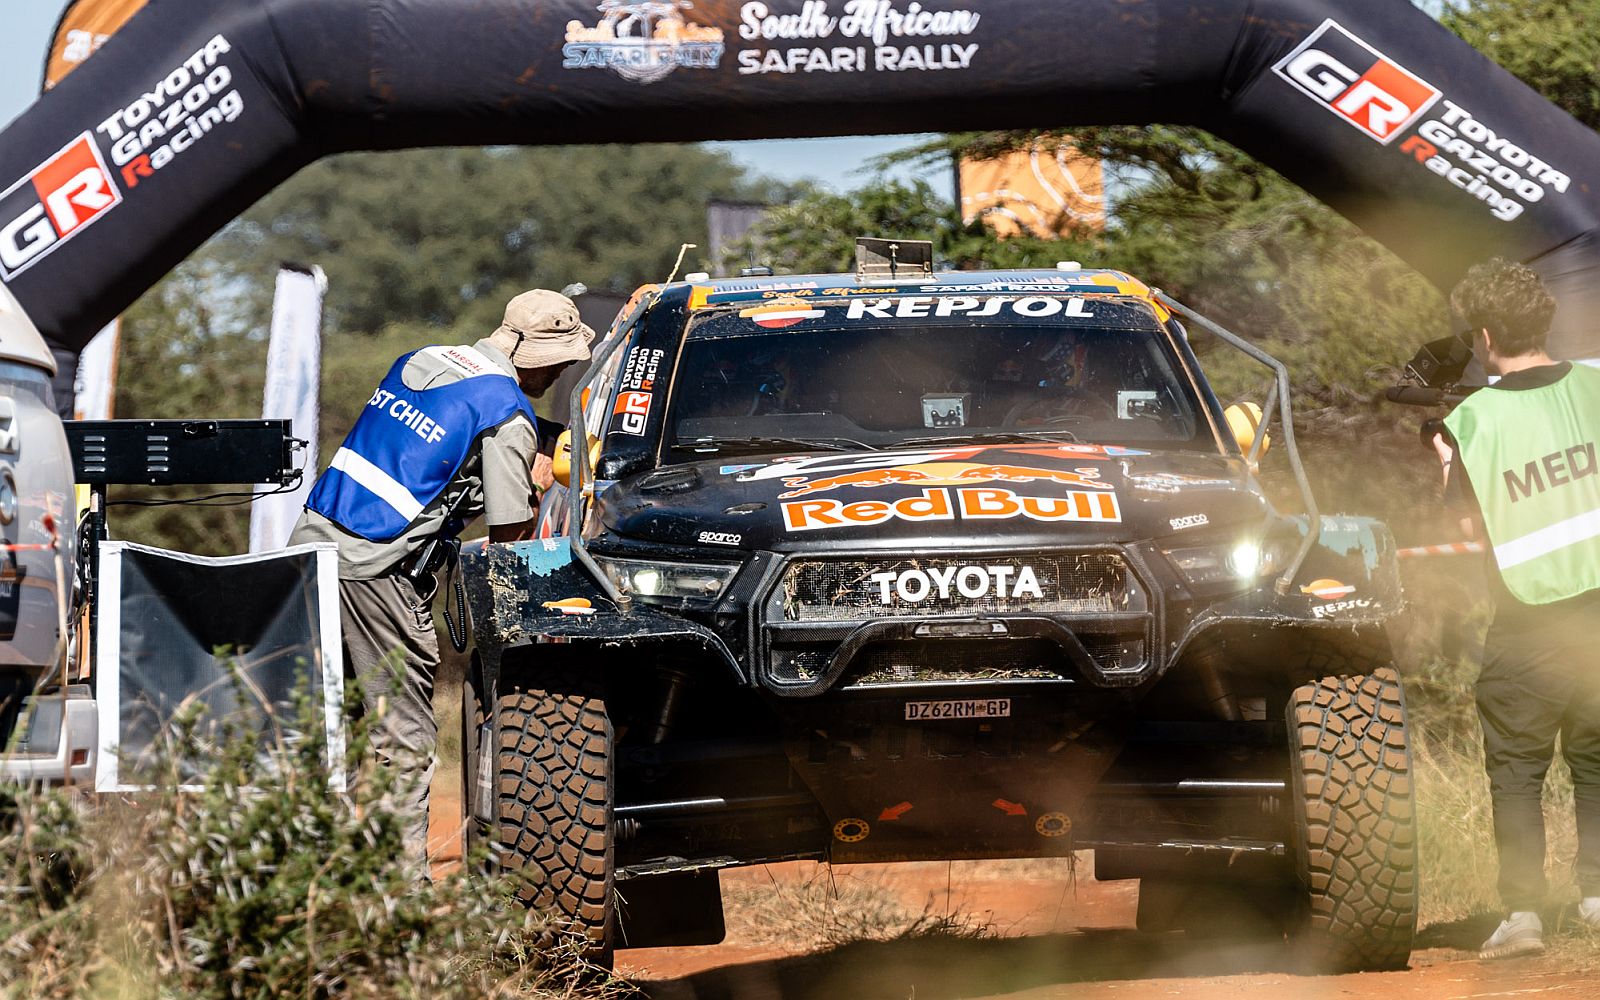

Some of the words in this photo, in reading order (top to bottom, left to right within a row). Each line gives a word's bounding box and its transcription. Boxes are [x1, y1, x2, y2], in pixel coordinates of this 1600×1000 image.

[738, 0, 838, 40] South
[838, 0, 981, 47] African
[562, 42, 653, 69] SAFARI
[737, 46, 866, 75] SAFARI
[875, 43, 979, 71] RALLY
[97, 34, 231, 140] TOYOTA
[1286, 49, 1412, 139] GR
[111, 65, 232, 166] GAZOO
[120, 90, 244, 189] Racing
[1418, 119, 1545, 203] GAZOO
[1441, 100, 1571, 194] TOYOTA
[1400, 135, 1525, 222] Racing
[0, 166, 116, 269] GR
[762, 289, 816, 299] South
[822, 287, 898, 296] African
[920, 283, 1003, 293] SAFARI
[1008, 282, 1071, 292] RALLY
[847, 295, 1094, 320] REPSOL
[446, 350, 484, 372] MARSHAL
[620, 345, 640, 392] TOYOTA
[630, 347, 650, 390] GAZOO
[641, 348, 665, 391] Racing
[366, 387, 397, 409] ST
[389, 399, 447, 444] CHIEF
[622, 393, 650, 434] GR
[783, 488, 954, 531] Red
[957, 488, 1121, 522] Bull
[1169, 514, 1209, 530] sparco
[698, 531, 742, 545] sparco
[871, 566, 1044, 605] TOYOTA
[908, 702, 976, 718] DZ62RM
[987, 700, 1009, 716] GP
